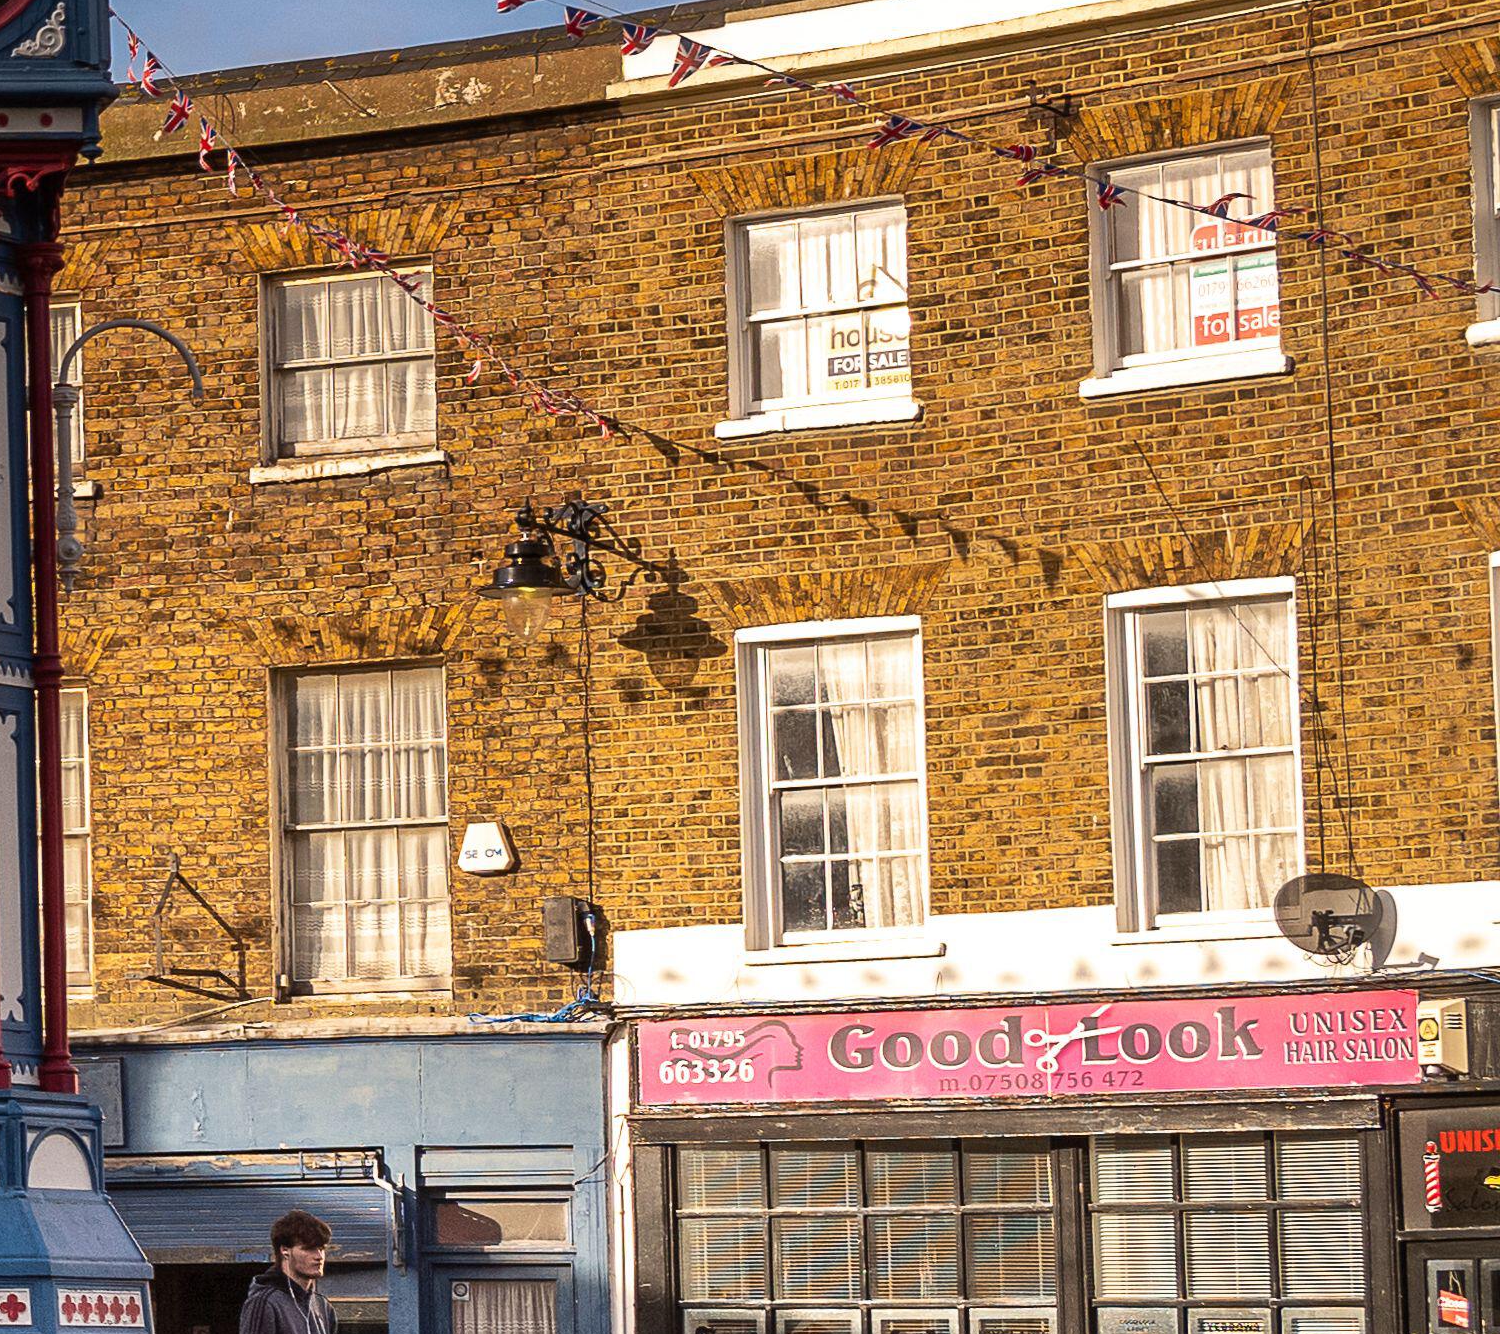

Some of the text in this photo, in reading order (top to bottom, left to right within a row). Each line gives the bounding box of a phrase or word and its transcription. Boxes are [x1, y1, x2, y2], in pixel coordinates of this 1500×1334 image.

[1239, 306, 1280, 332] sale
[868, 350, 908, 371] SALE
[1289, 1008, 1408, 1037] UNISEX
[688, 1030, 746, 1049] 01795
[827, 1006, 1264, 1072] Good Look
[1283, 1034, 1415, 1065] HAIR SALON
[658, 1058, 755, 1085] 663326
[1052, 1070, 1094, 1090] 756
[1102, 1069, 1145, 1088] 472
